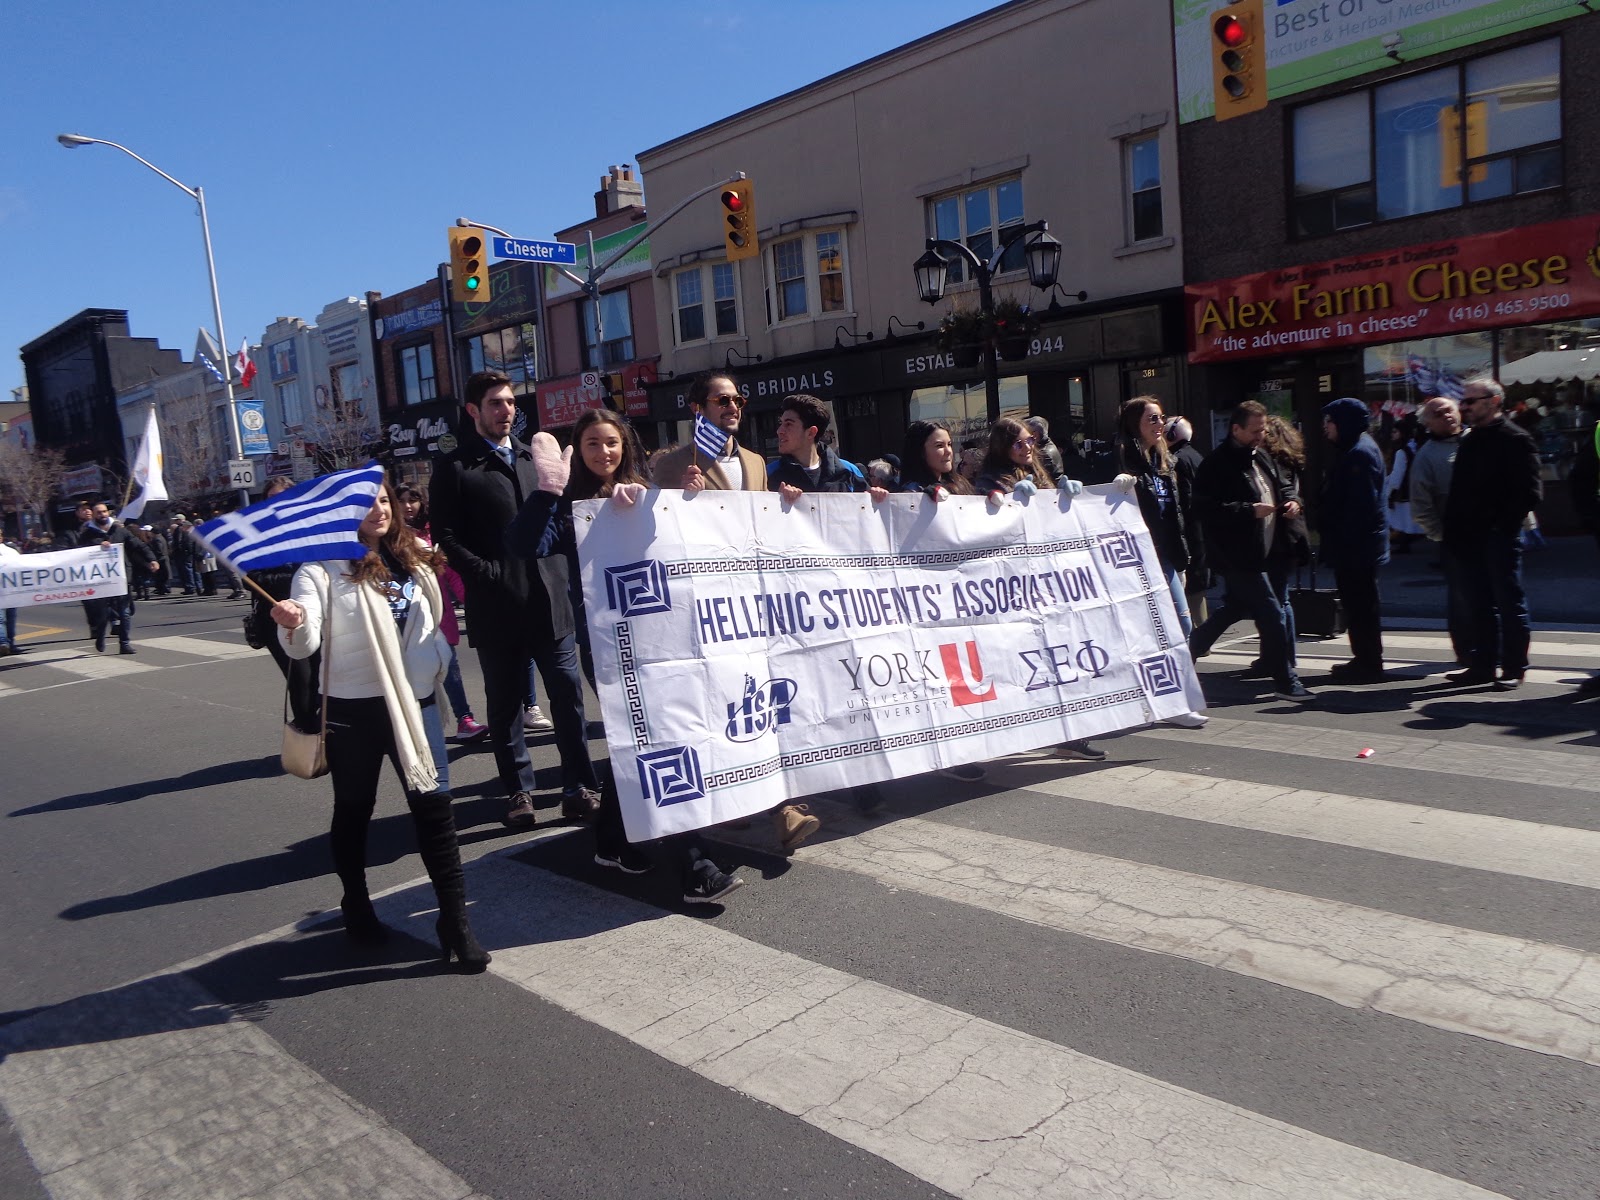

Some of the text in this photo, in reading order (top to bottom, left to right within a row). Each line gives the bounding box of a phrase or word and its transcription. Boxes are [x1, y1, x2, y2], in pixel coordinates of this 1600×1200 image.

[1275, 2, 1330, 38] Best
[1338, 11, 1394, 39] Herbal
[505, 240, 554, 259] Chester
[1197, 254, 1569, 335] Alex Farm Cheese
[1448, 293, 1571, 323] (416) 465.9500
[1252, 330, 1332, 348] adventure
[1337, 321, 1354, 338] in
[757, 370, 834, 396] BRIDALS
[1142, 368, 1155, 378] 381
[416, 417, 448, 440] Nails
[233, 471, 252, 484] 40
[1, 561, 120, 589] NEPOMAK
[696, 566, 1099, 645] HELLENIC STUDENTS' ASSOCIATION
[838, 650, 940, 691] YORK
[849, 700, 949, 725] UNIVERSITY
